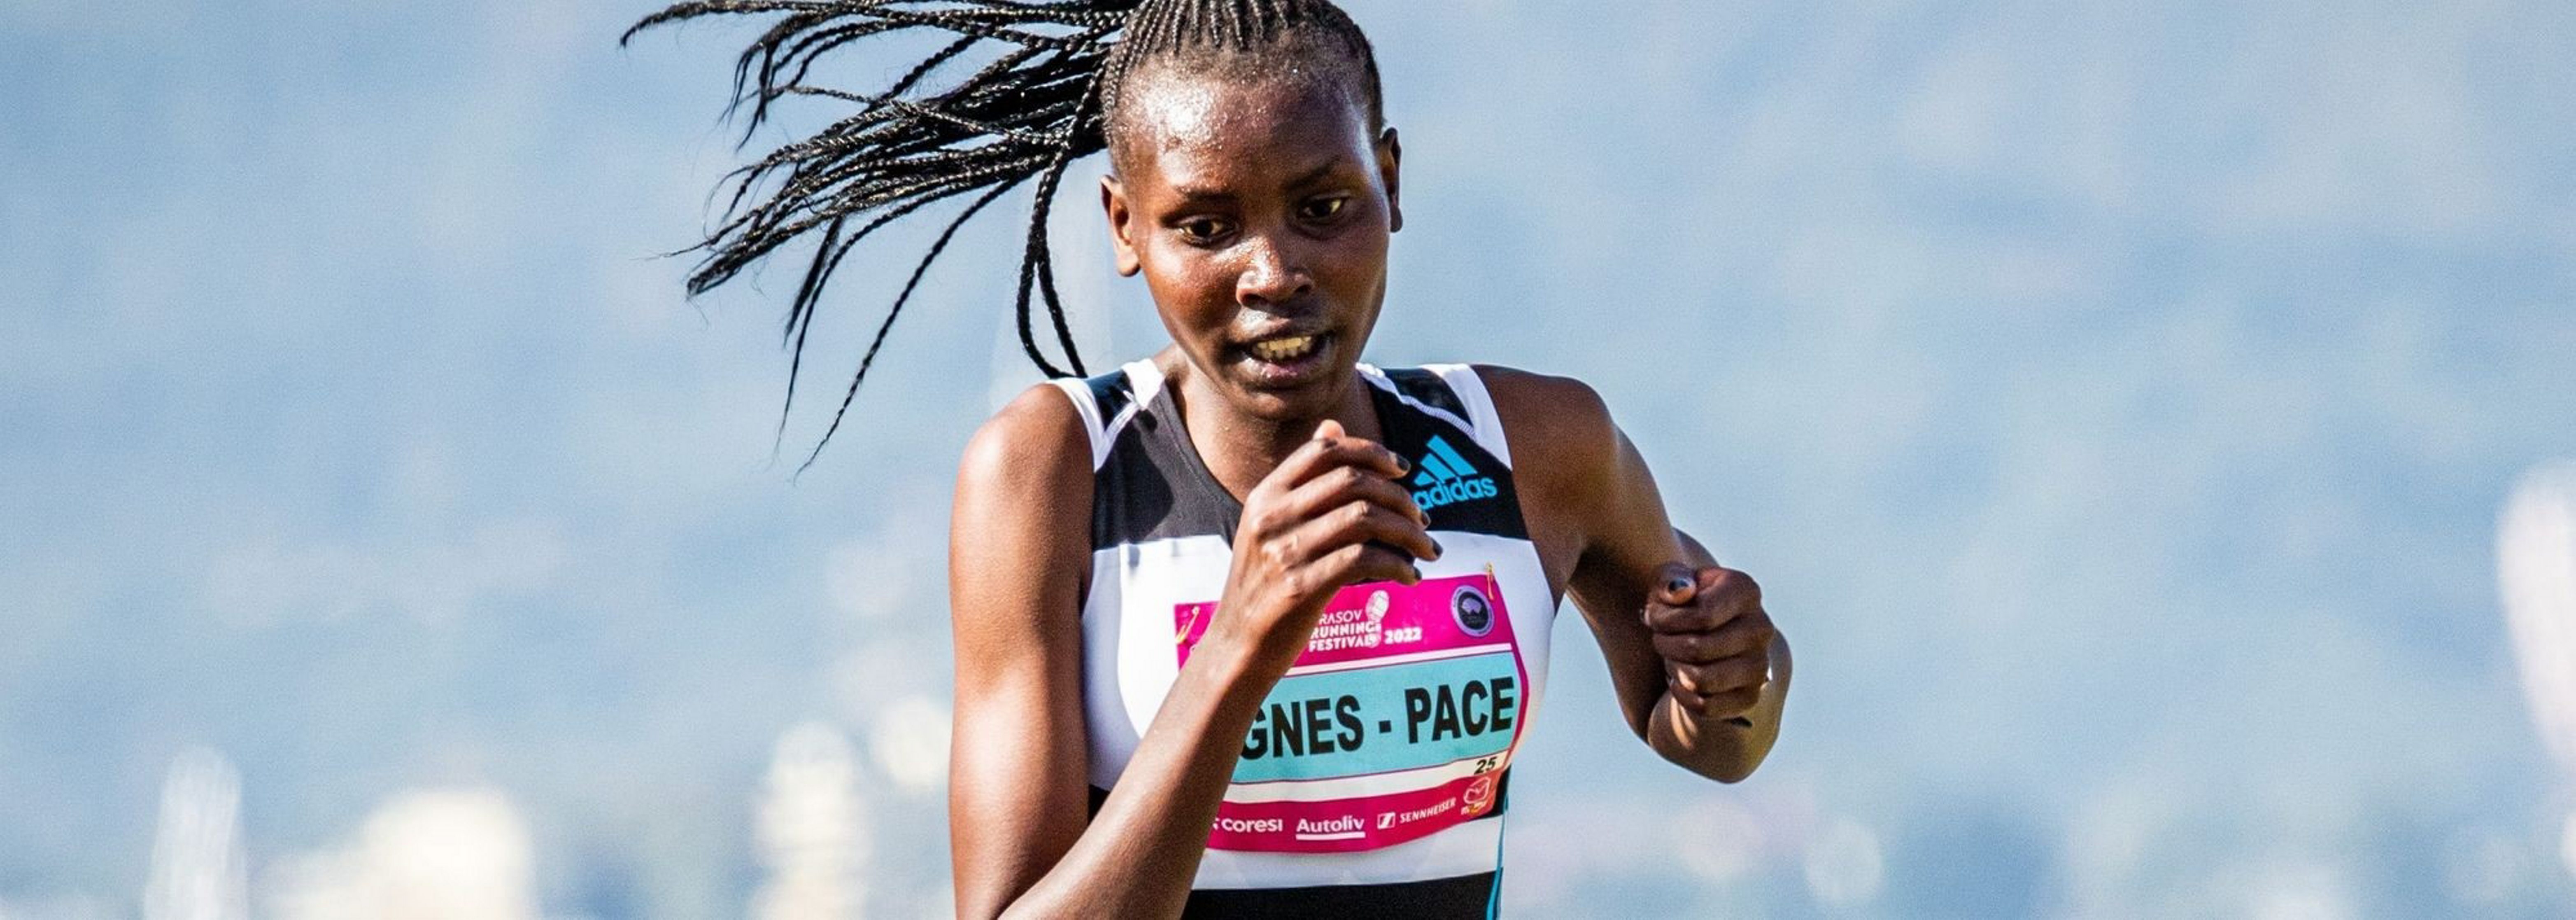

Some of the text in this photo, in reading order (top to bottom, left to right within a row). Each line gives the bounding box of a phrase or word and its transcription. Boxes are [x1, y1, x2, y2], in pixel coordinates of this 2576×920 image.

[1414, 476, 1498, 510] adidas
[1319, 609, 1363, 624] RASOV
[1309, 627, 1421, 652] FESTIVAL 2022
[1241, 695, 1364, 760] GNES
[1405, 677, 1514, 743] PACE
[1474, 757, 1497, 774] 25
[1400, 797, 1456, 824] SENNHEISER
[1296, 815, 1364, 832] Autoliv
